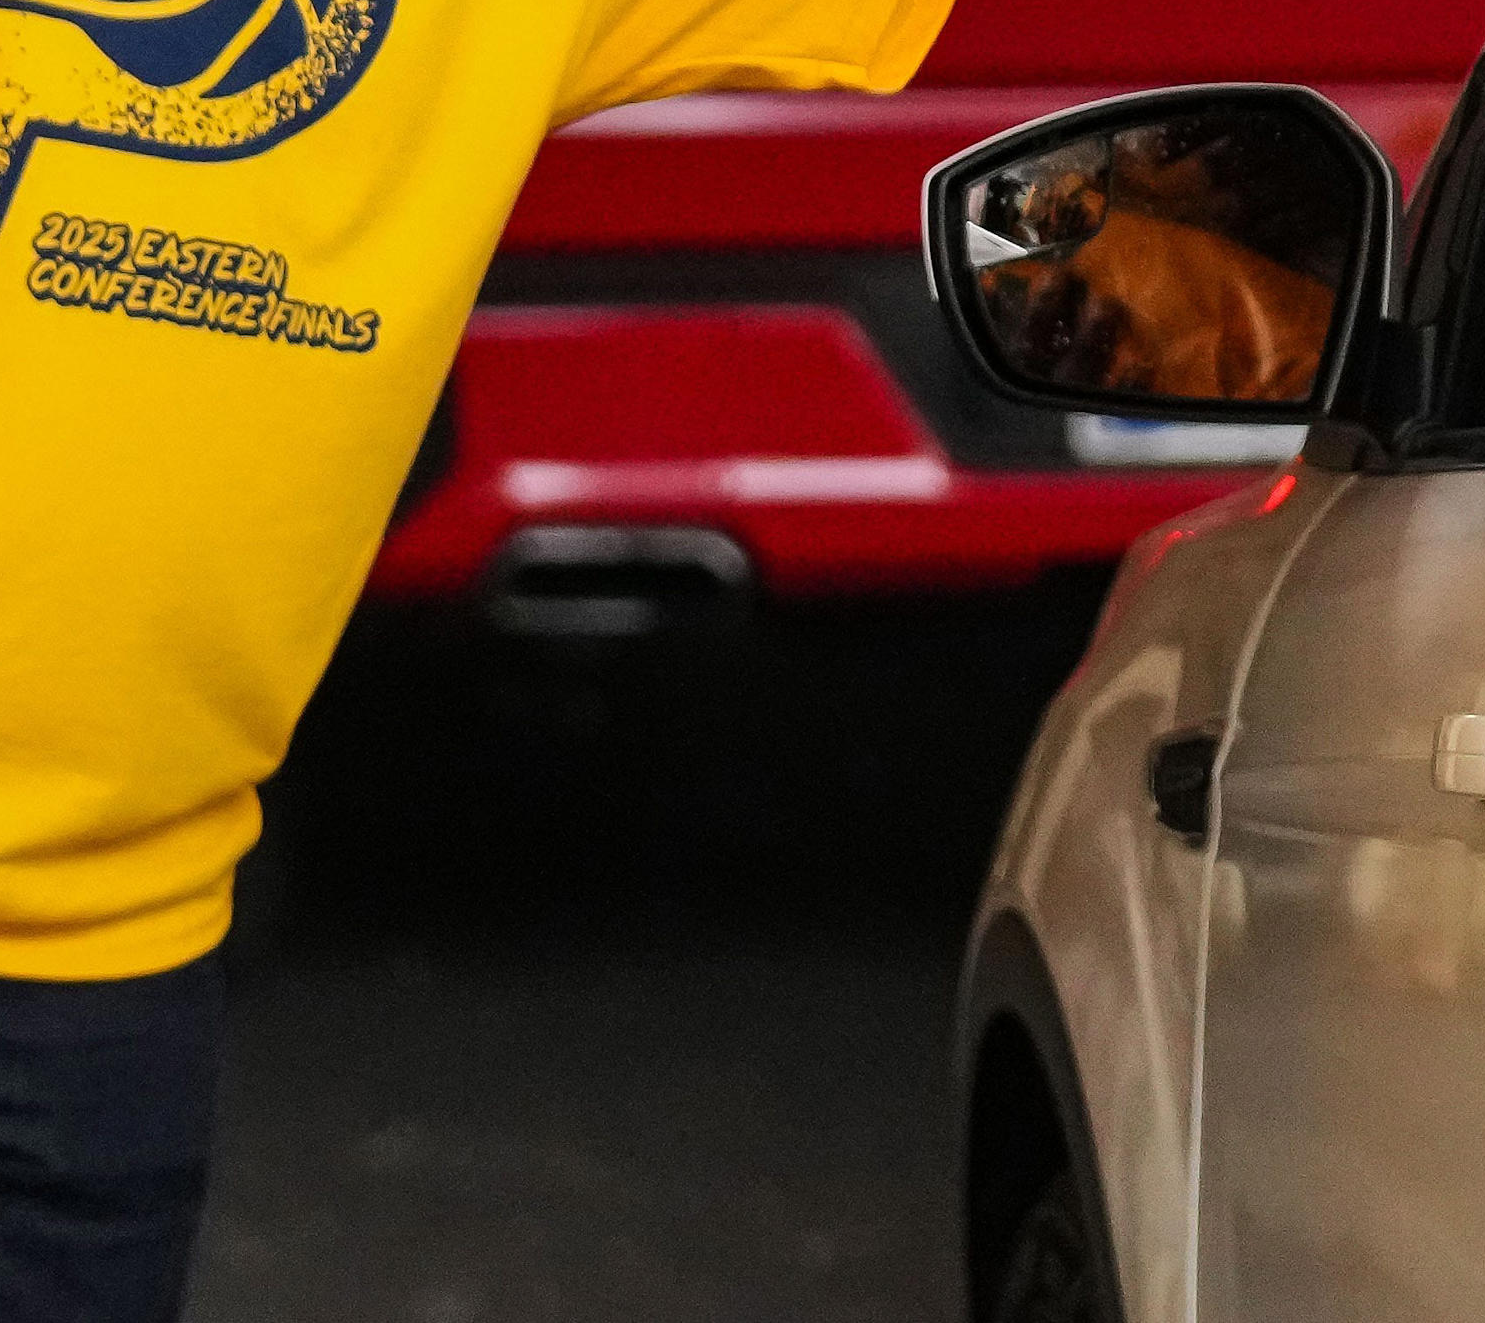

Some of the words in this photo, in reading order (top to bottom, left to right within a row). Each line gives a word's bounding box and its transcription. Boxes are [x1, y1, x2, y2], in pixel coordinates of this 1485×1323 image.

[33, 211, 132, 268] 2025
[133, 227, 289, 293] EASTERN
[27, 257, 262, 336] CONFERENCE
[266, 296, 381, 353] FINALS
